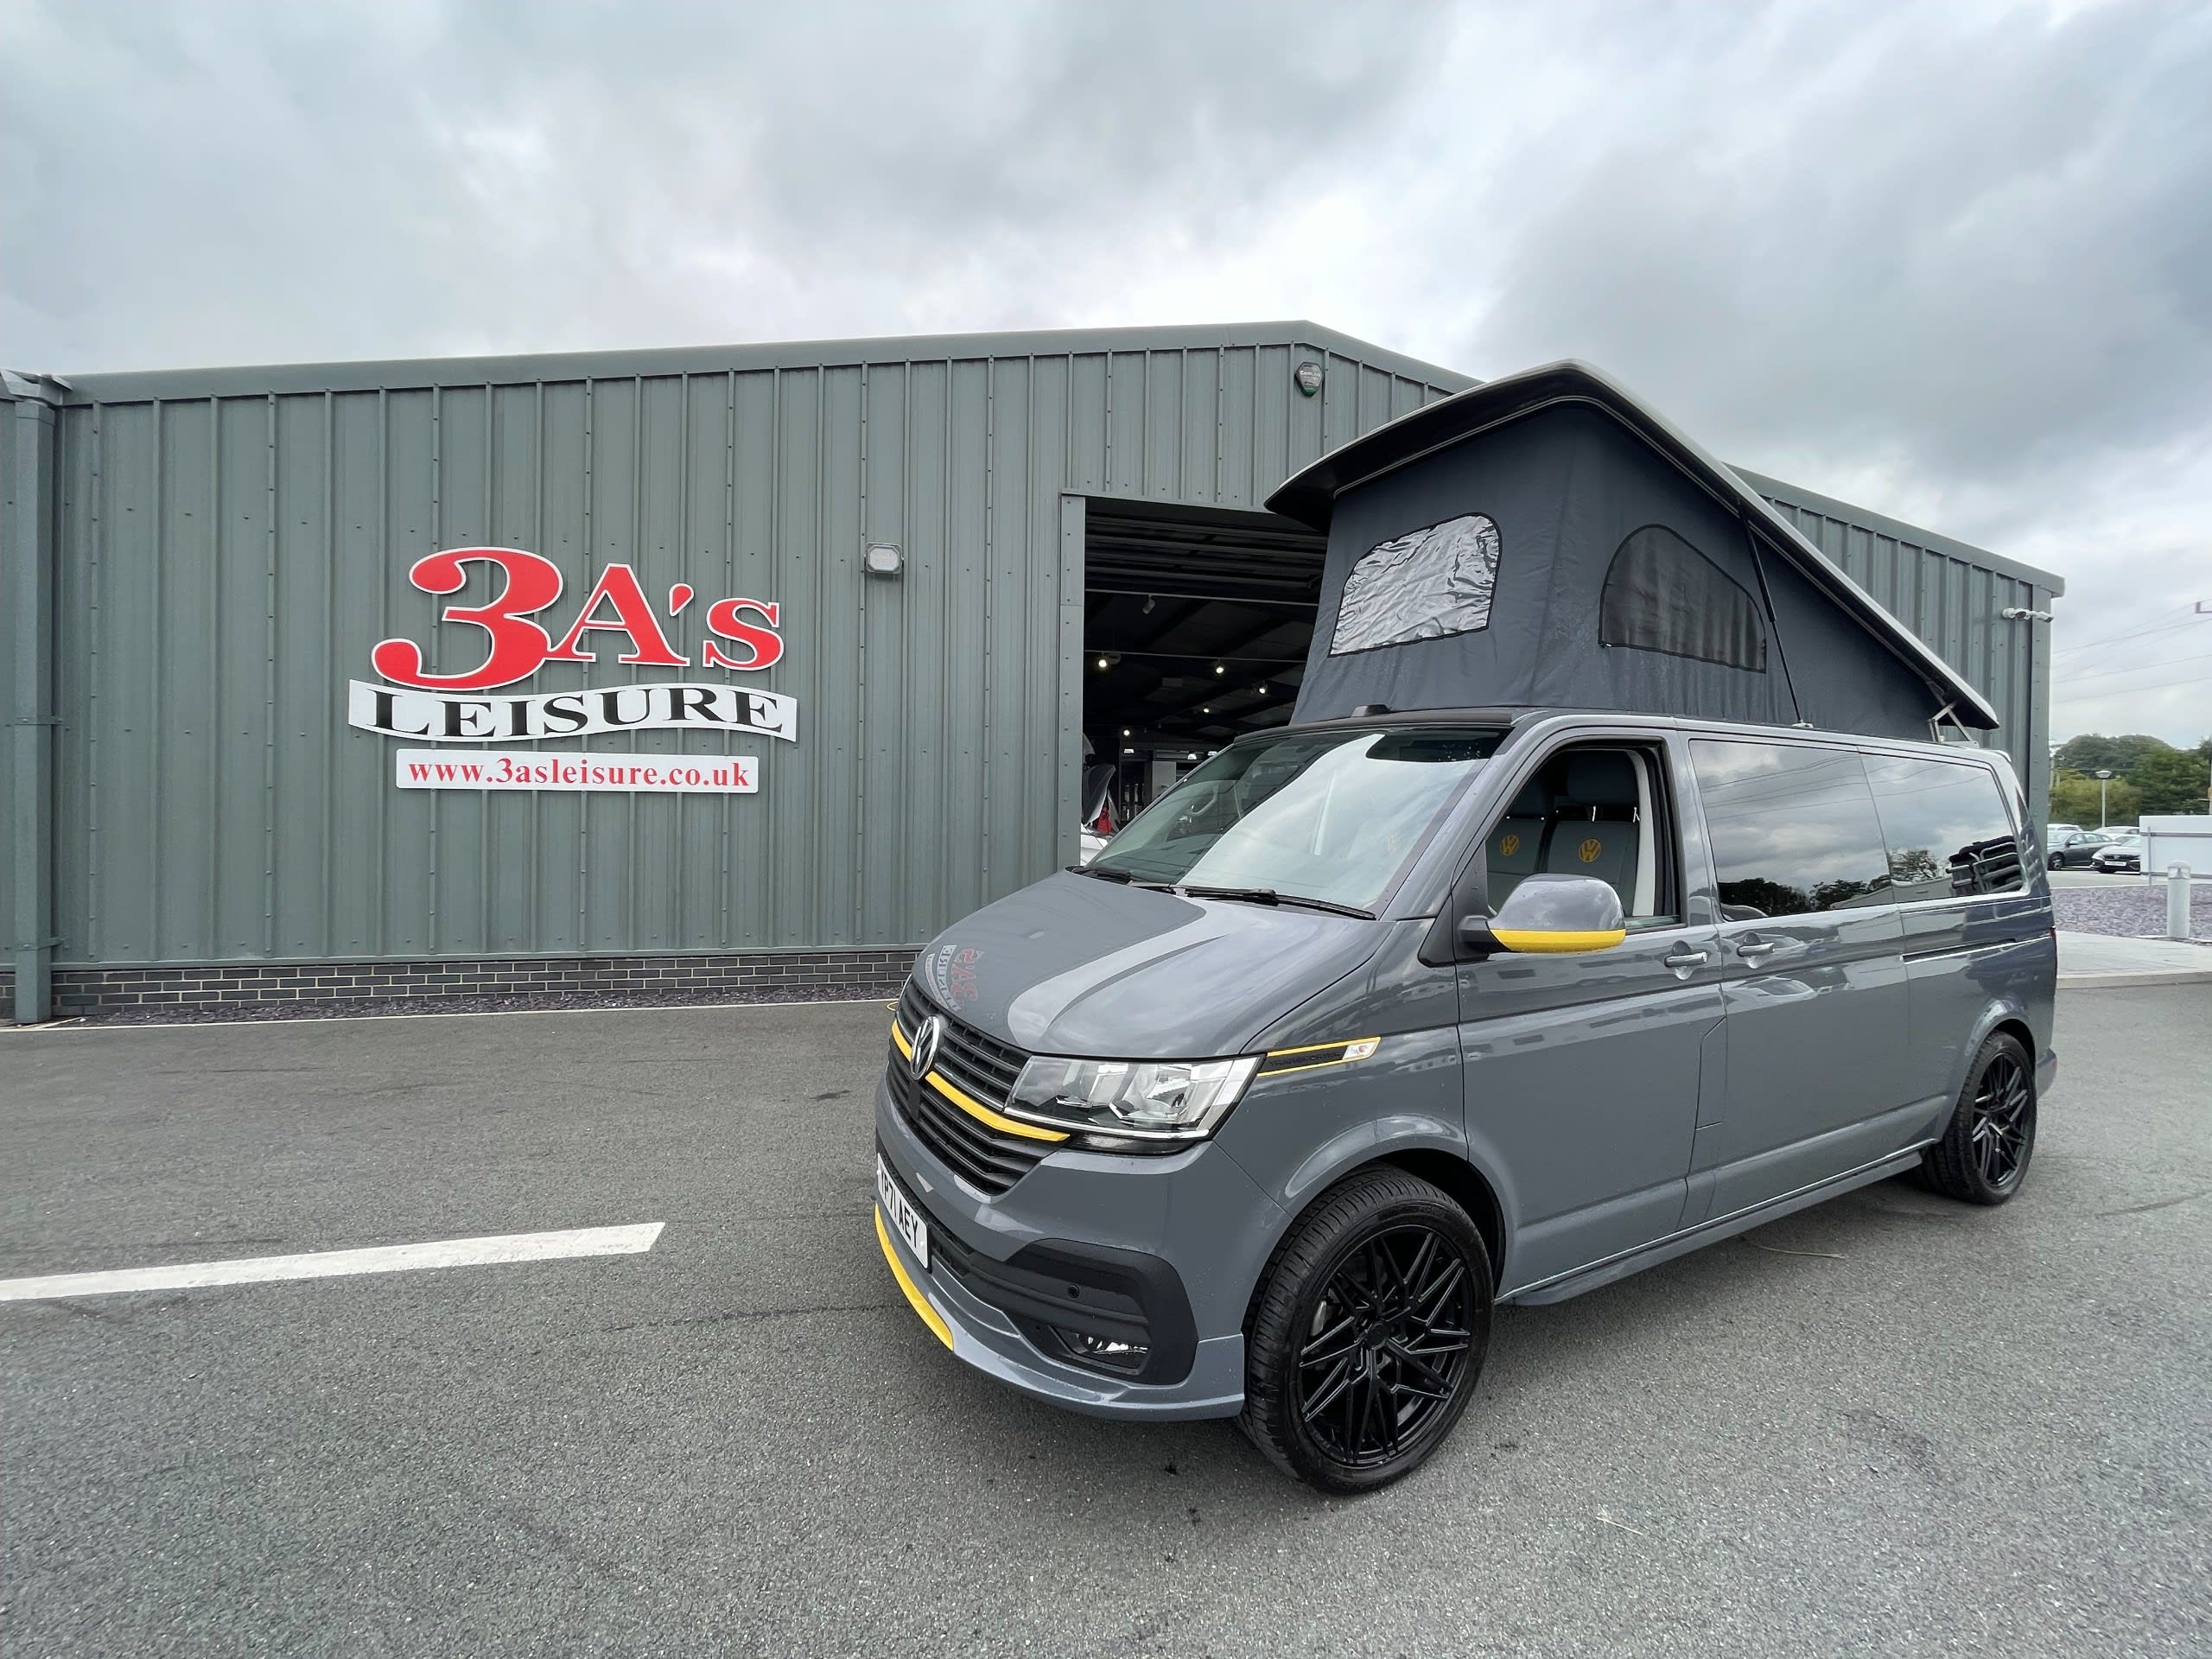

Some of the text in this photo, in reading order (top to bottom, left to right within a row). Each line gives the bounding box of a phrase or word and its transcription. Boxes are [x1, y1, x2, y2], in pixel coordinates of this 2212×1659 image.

[371, 547, 785, 690] 3A's
[366, 688, 783, 738] LEISURE
[408, 757, 750, 787] www.3asleisure.co.uk
[899, 1198, 918, 1249] AEY
